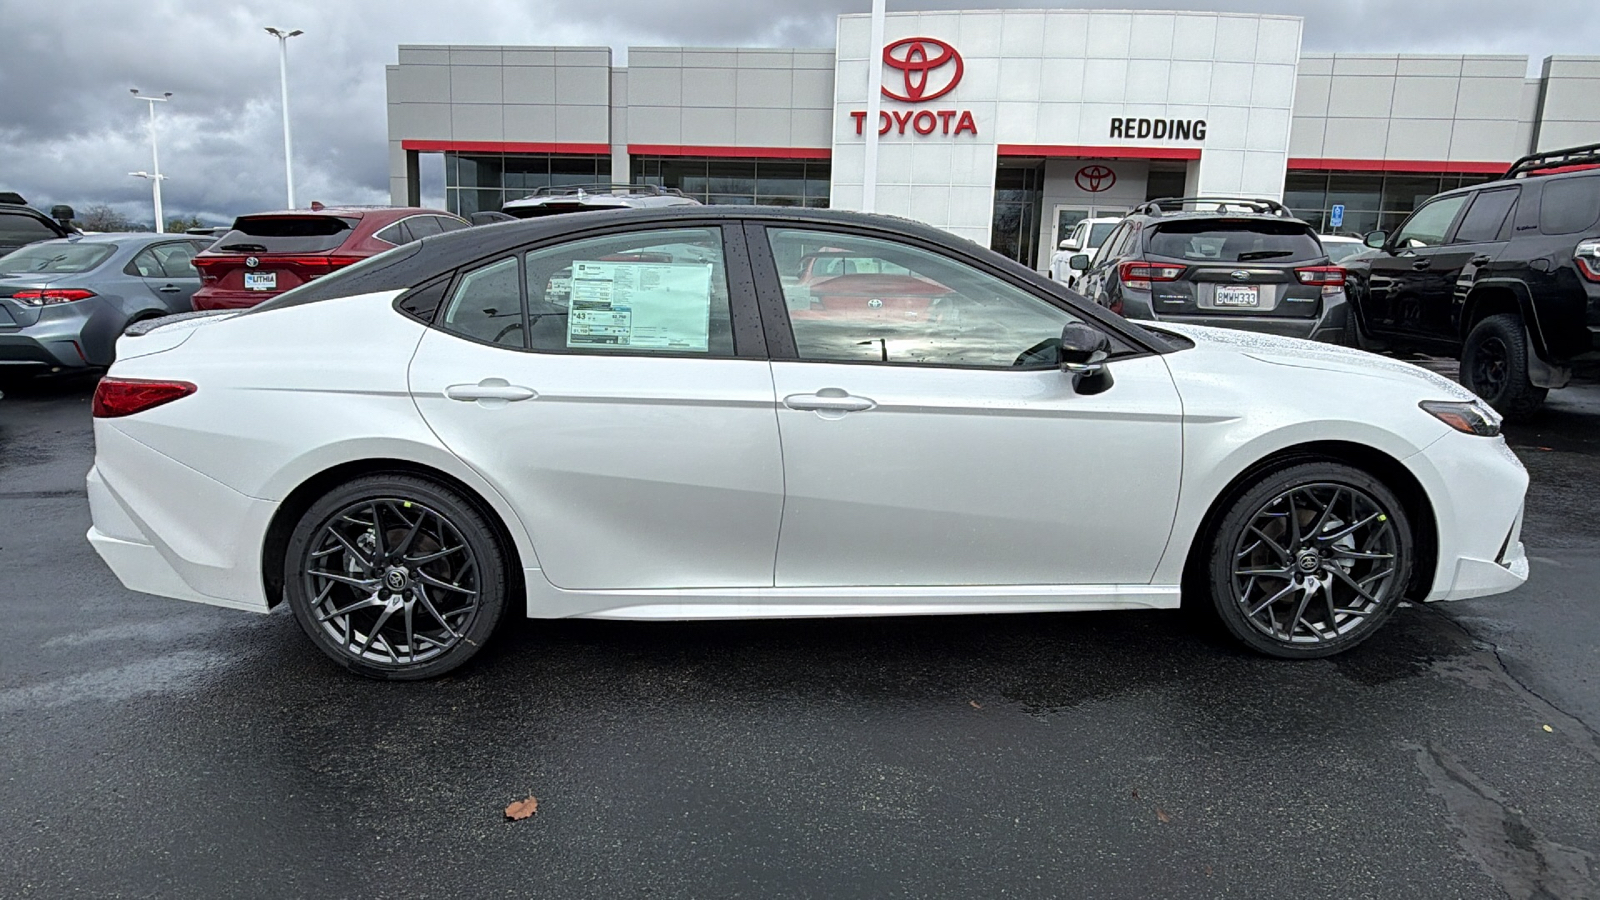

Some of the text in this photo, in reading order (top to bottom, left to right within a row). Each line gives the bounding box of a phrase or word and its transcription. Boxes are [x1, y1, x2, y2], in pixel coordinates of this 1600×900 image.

[1109, 117, 1207, 141] REDDING
[252, 275, 275, 283] LITHIA
[1217, 292, 1256, 304] 8MWH333
